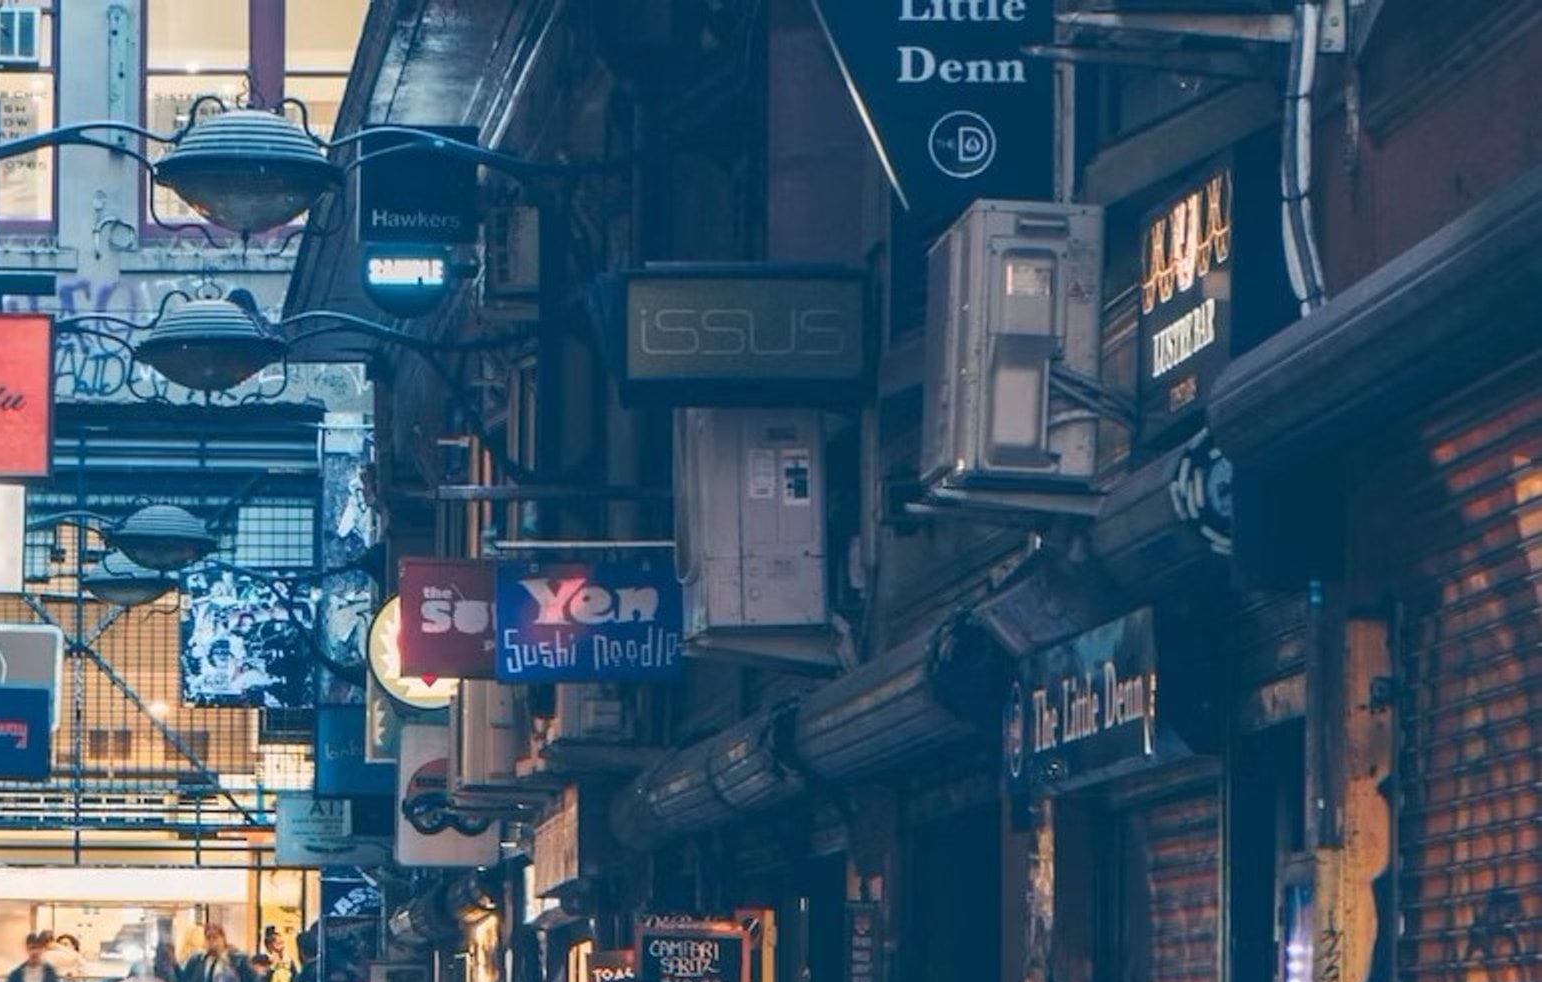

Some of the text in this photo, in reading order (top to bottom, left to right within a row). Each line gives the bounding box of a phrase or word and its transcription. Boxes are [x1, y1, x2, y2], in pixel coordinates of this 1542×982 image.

[898, 0, 1026, 21] Little
[896, 46, 1027, 83] Denn
[371, 209, 461, 229] Hawkers
[423, 585, 453, 599] the
[519, 577, 659, 625] Yen
[504, 628, 577, 673] Sushi
[1062, 671, 1099, 743] Little
[1104, 661, 1145, 729] Denn
